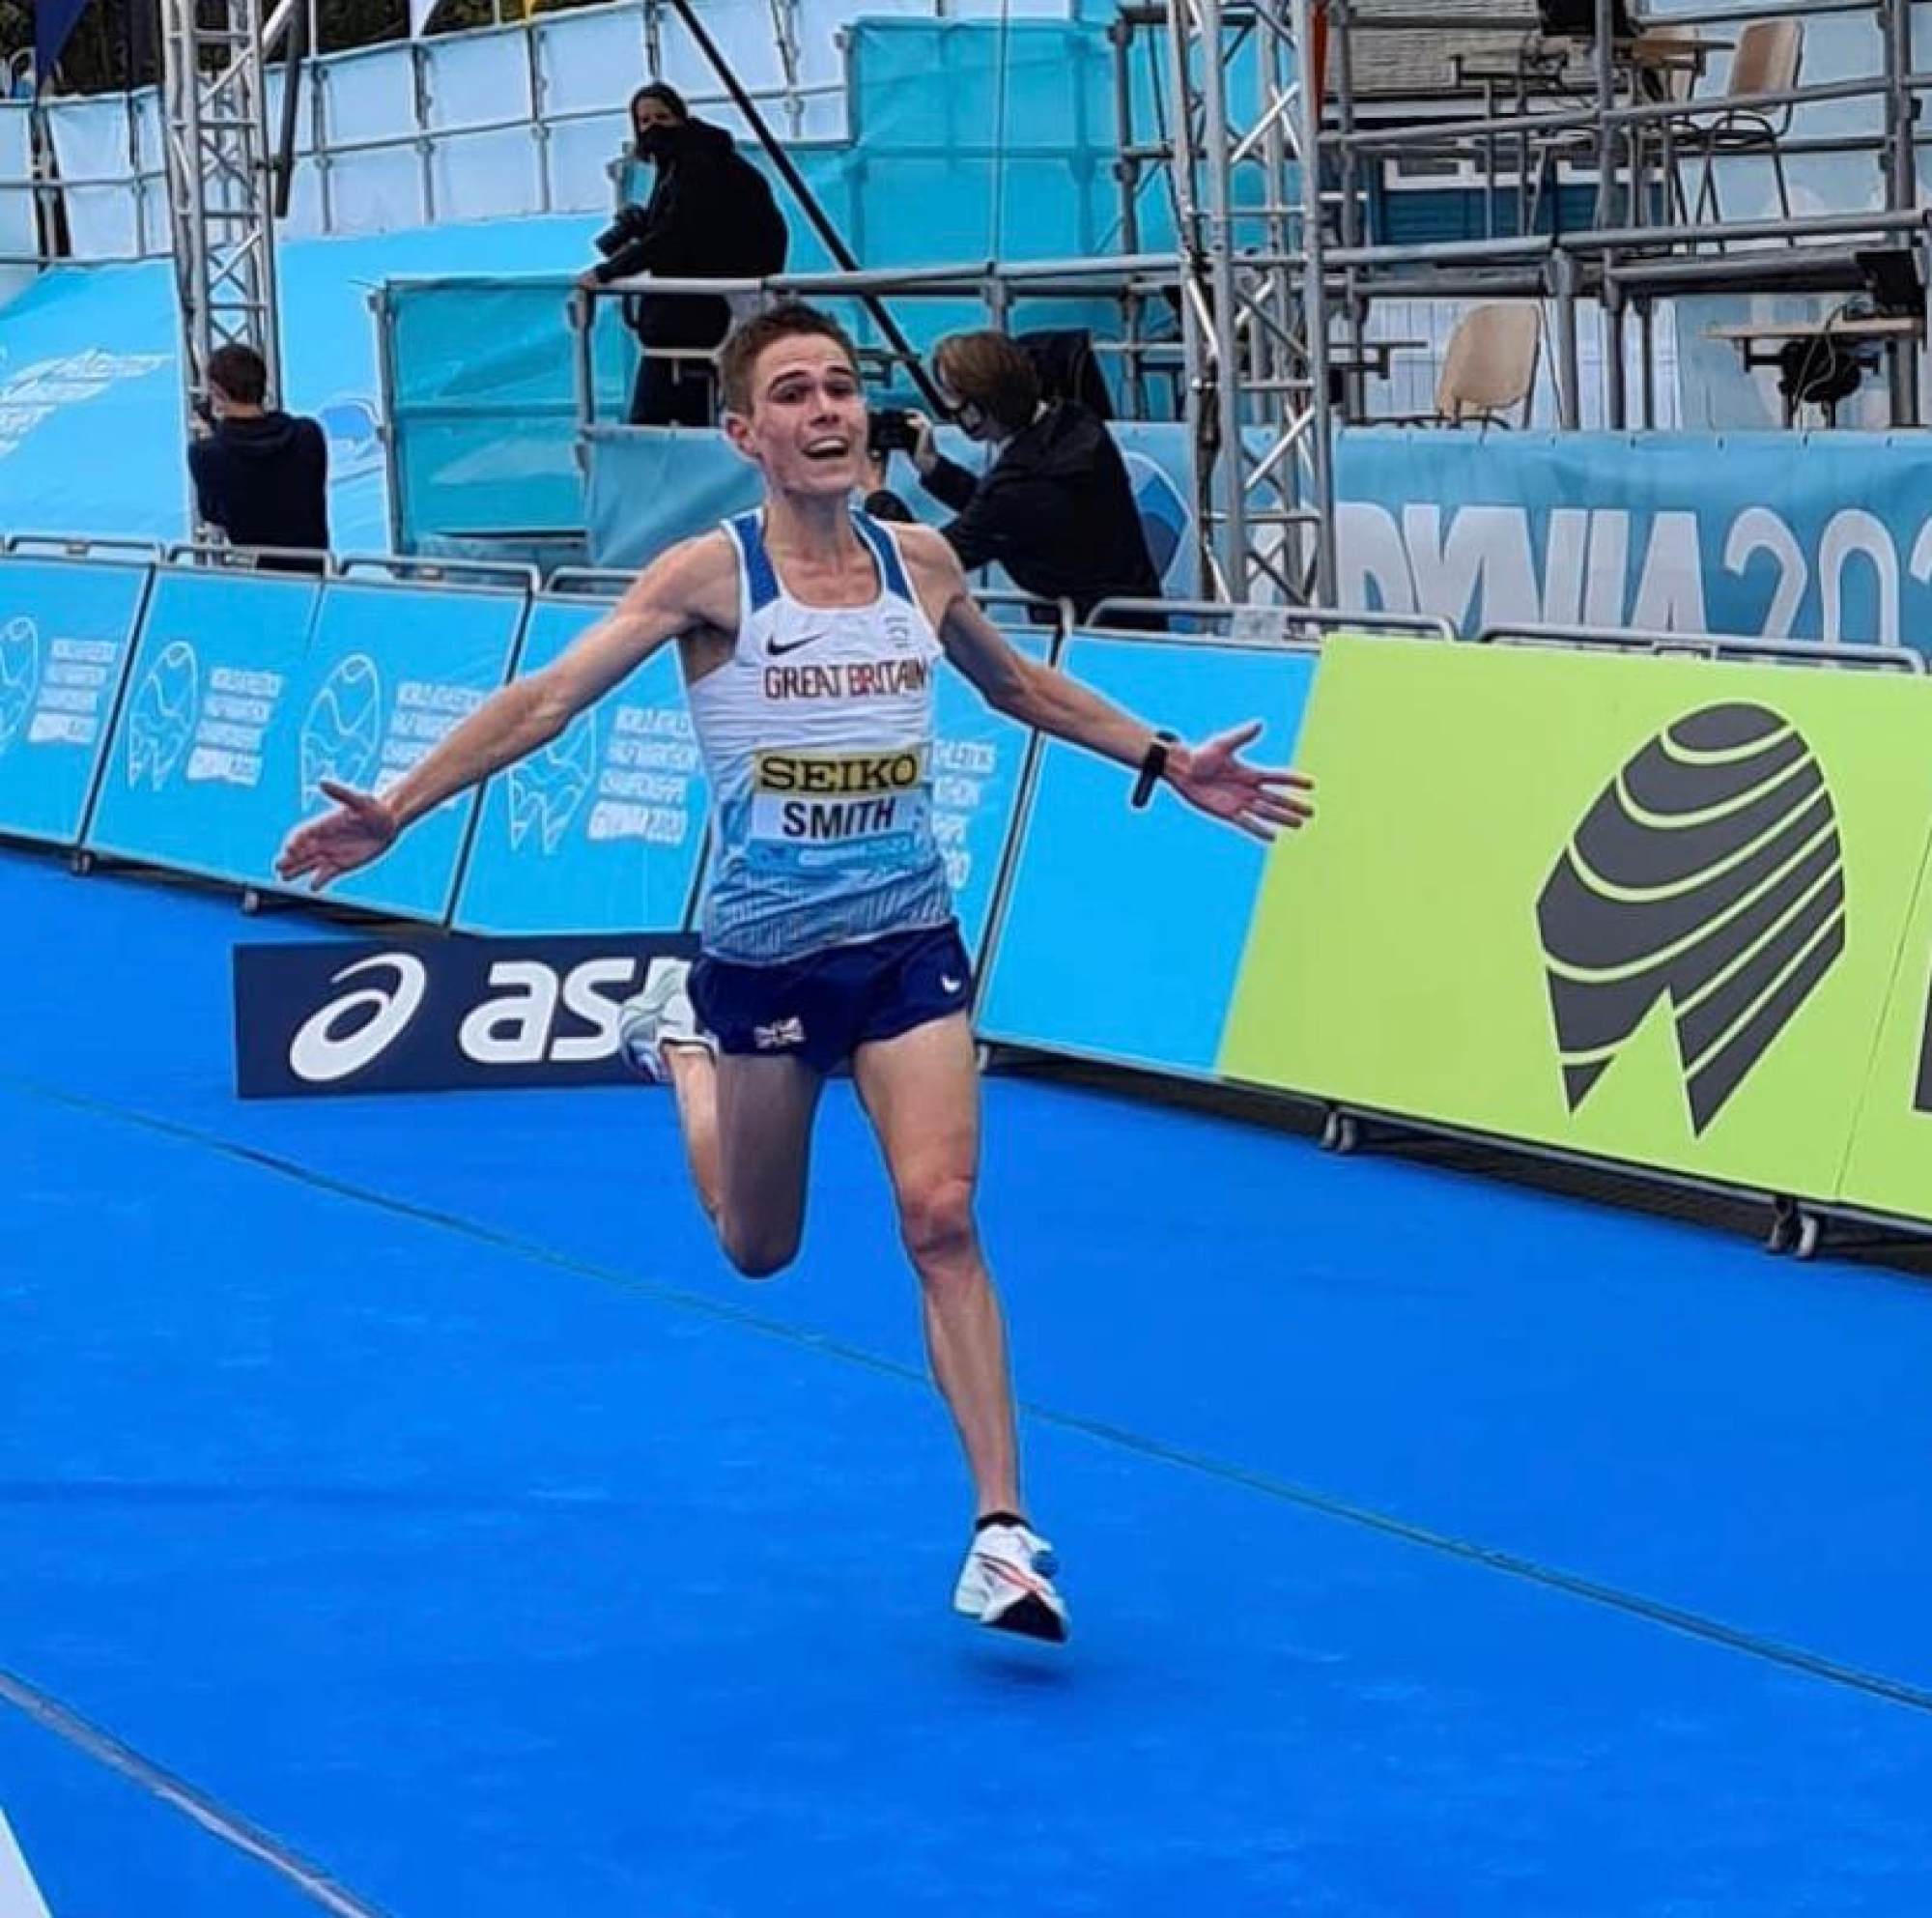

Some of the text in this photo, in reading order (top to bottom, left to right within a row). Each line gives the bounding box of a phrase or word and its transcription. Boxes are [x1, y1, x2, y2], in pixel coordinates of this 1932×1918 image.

[765, 664, 843, 700] GREAT
[760, 754, 919, 792] SEIKO
[782, 796, 896, 841] SMITH
